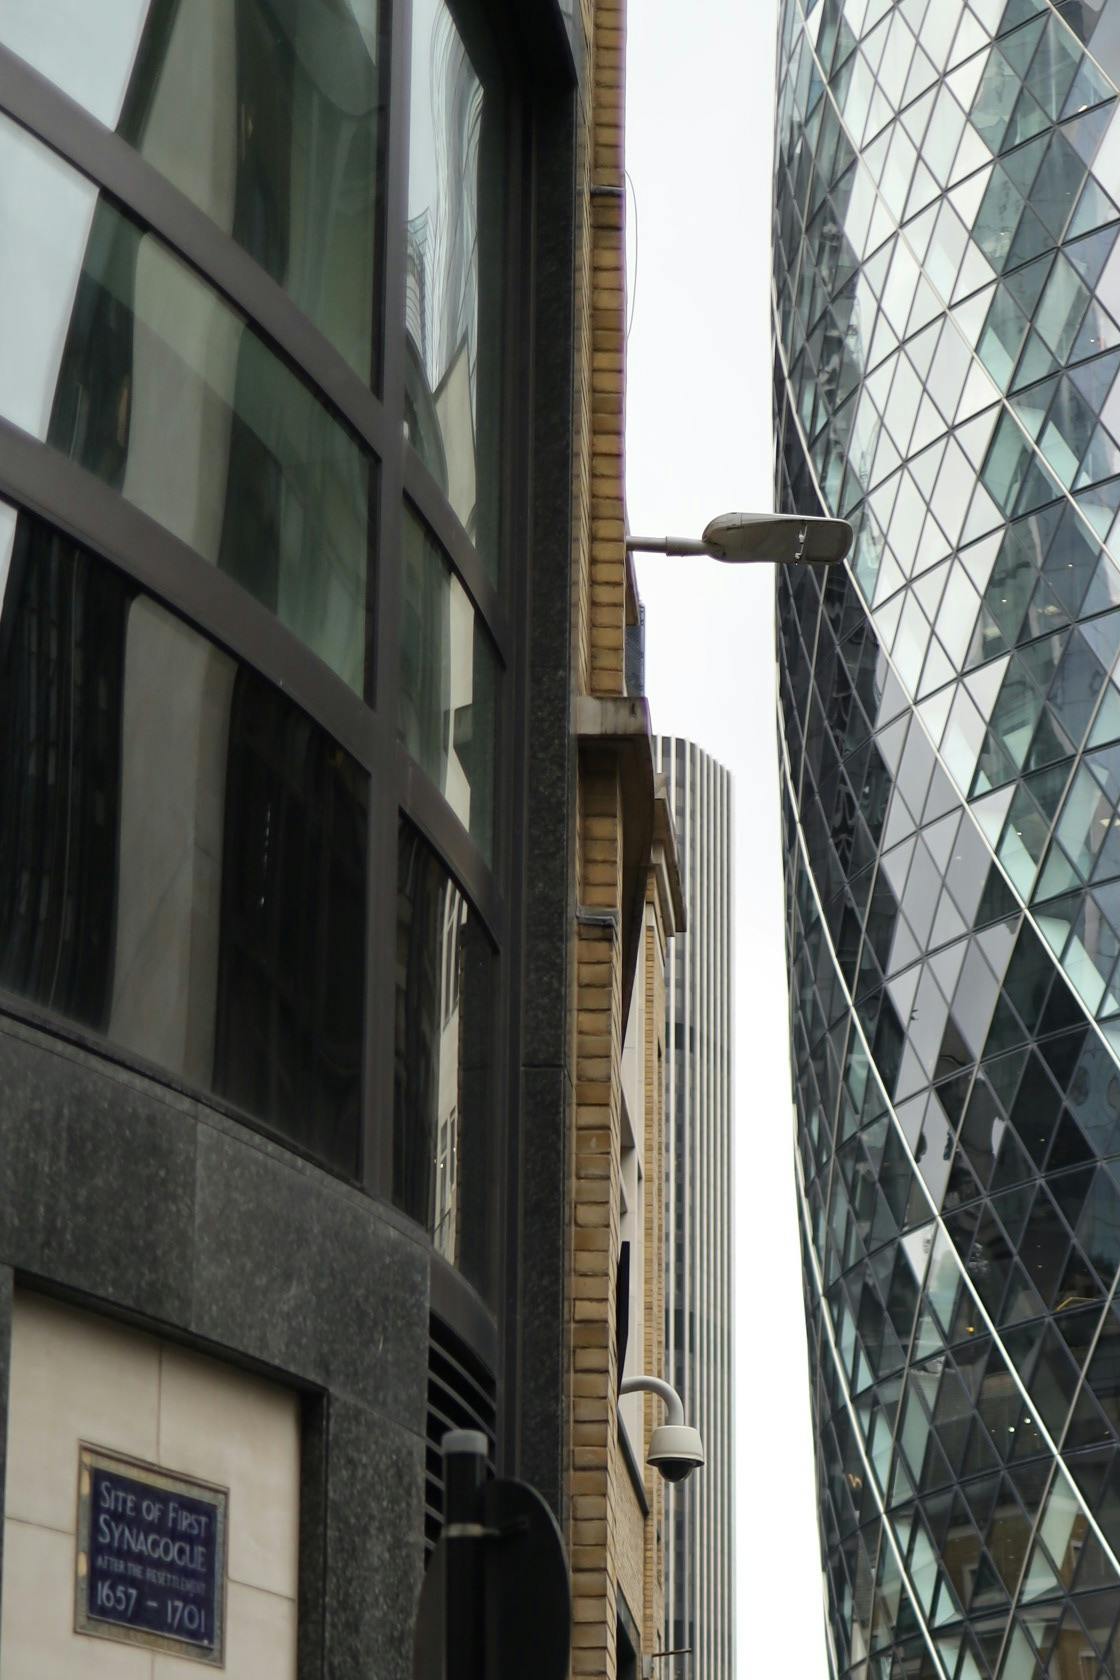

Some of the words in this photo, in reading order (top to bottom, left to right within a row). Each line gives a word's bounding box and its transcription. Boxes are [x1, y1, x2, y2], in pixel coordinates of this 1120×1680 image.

[100, 1481, 136, 1516] SITE
[142, 1500, 164, 1524] OF
[168, 1502, 209, 1537] FIRST
[98, 1514, 207, 1571] SYNAGOGUE
[127, 1561, 144, 1578] THE
[97, 1579, 138, 1617] 1657
[166, 1599, 206, 1632] 1701
